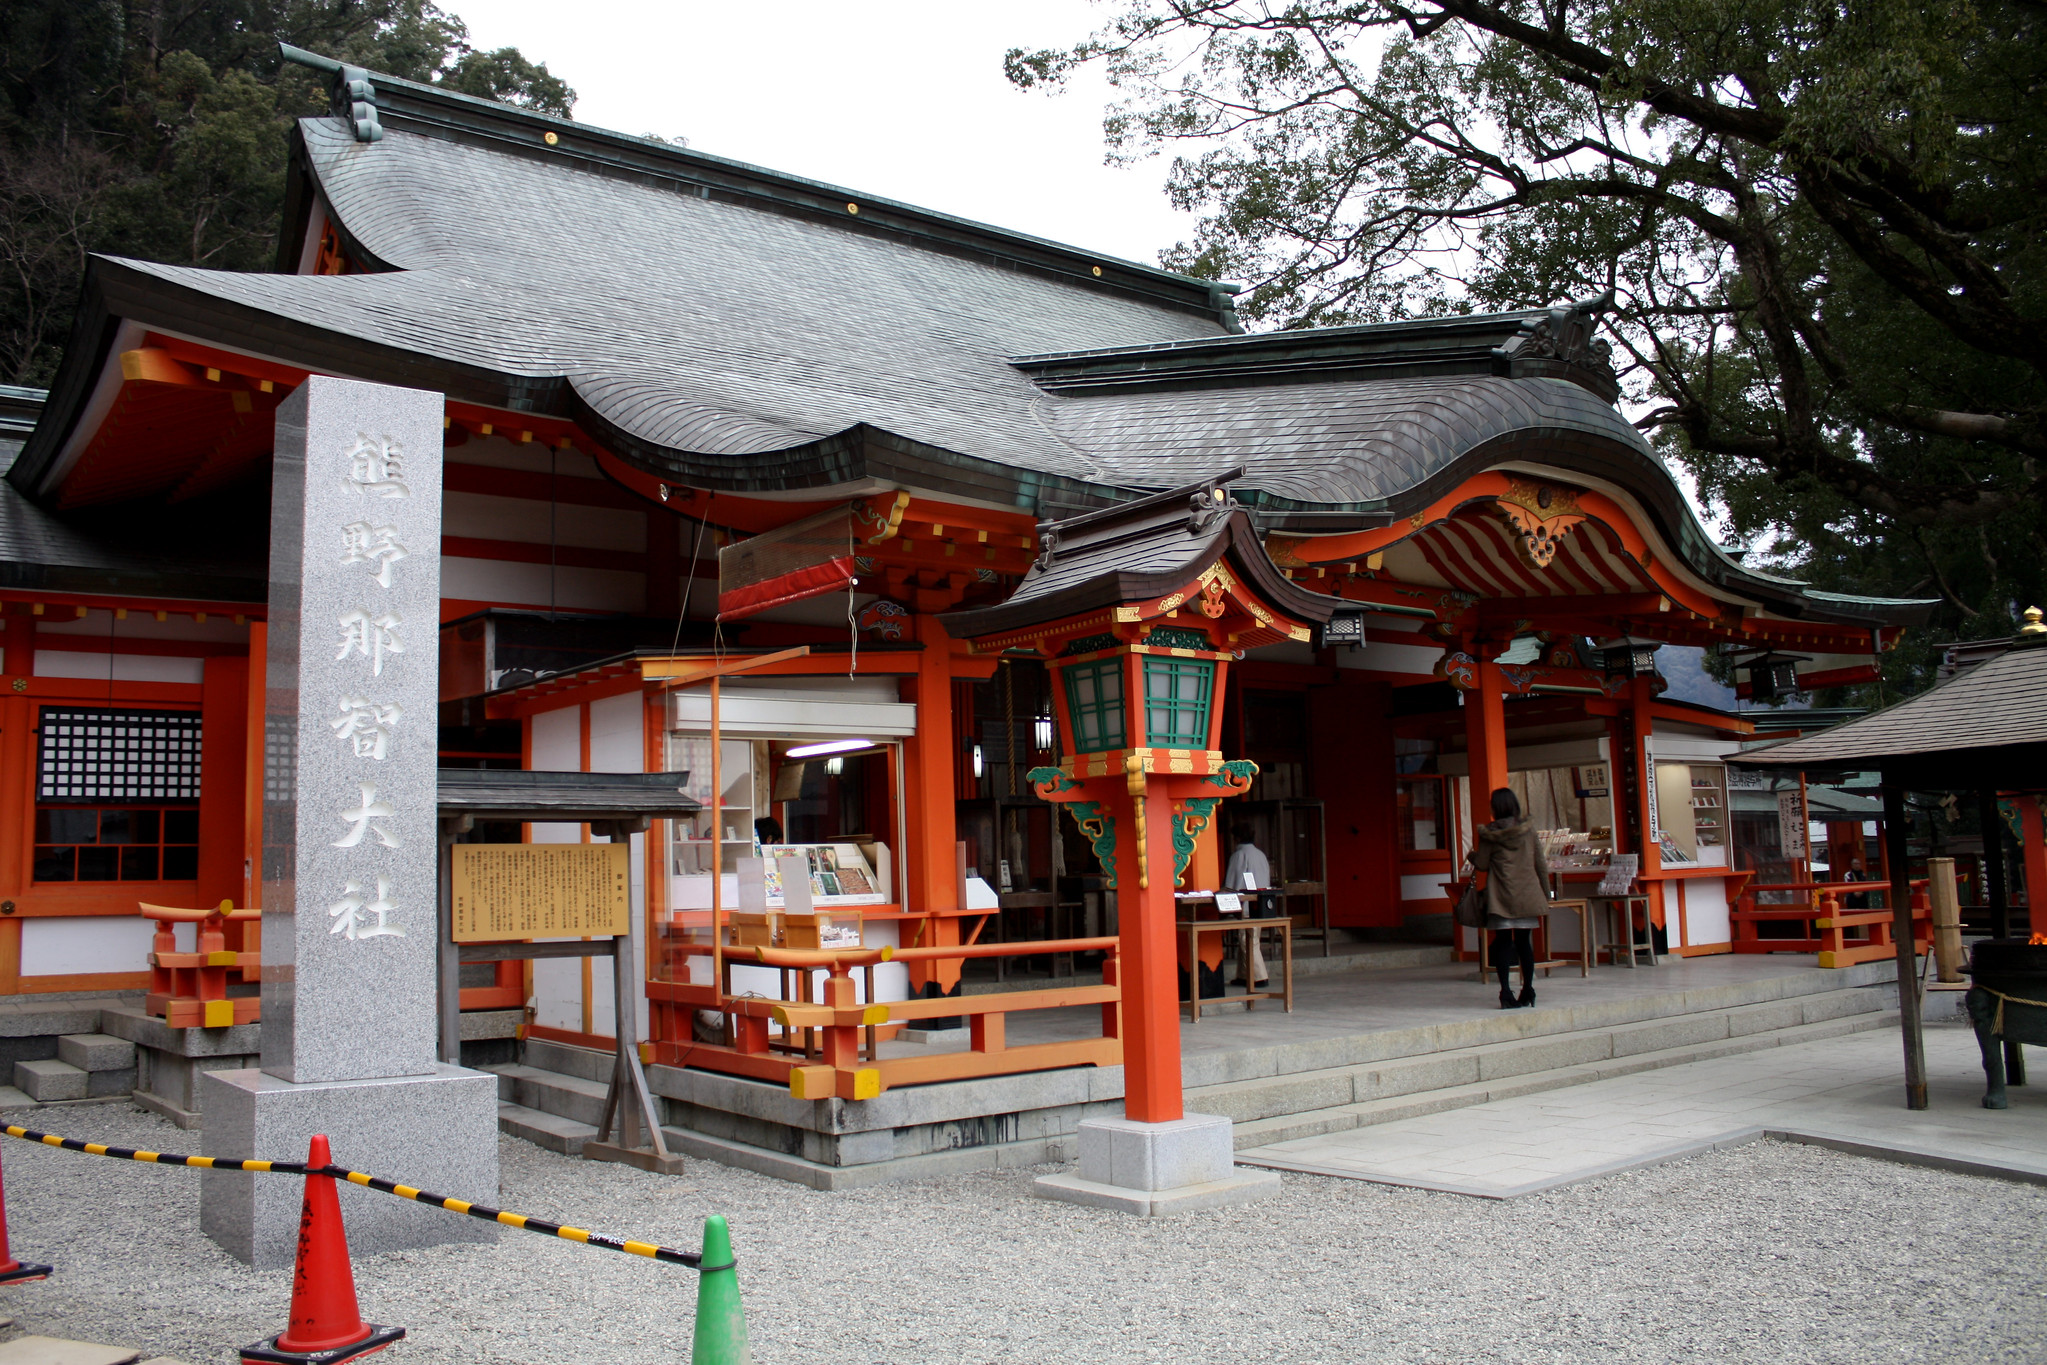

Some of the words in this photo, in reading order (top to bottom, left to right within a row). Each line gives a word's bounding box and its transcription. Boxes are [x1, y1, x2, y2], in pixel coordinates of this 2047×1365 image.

[329, 431, 411, 941] 熊野那智大社
